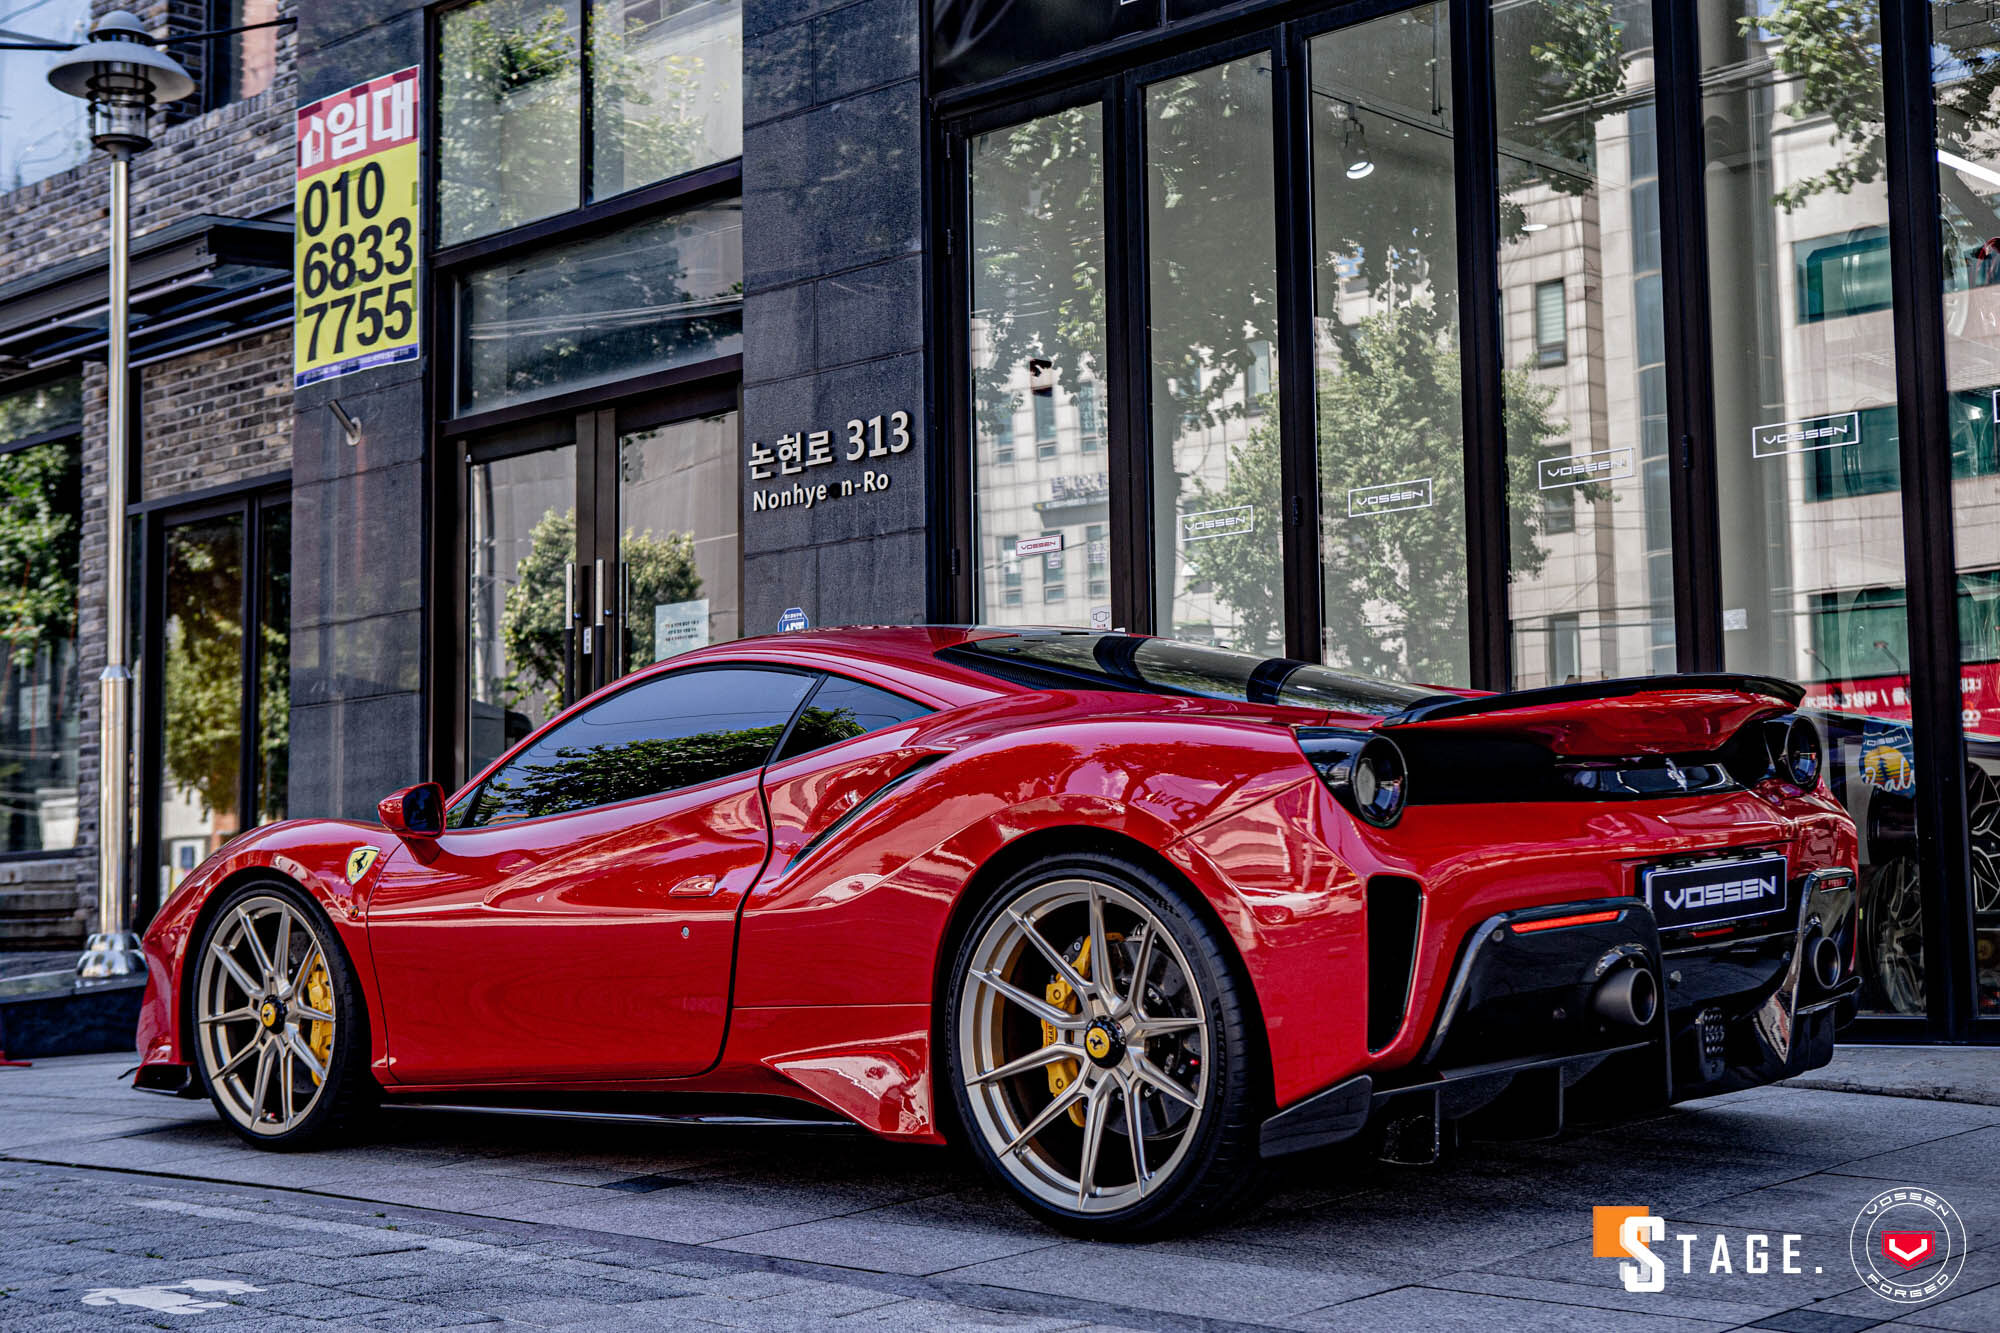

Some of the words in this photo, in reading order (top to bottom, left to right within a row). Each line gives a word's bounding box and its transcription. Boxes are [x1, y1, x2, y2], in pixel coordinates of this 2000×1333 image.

[326, 79, 414, 160] 임대
[303, 161, 385, 238] 010
[303, 216, 413, 299] 6833
[303, 279, 412, 363] 7755
[748, 430, 832, 480] 논현로
[846, 410, 910, 461] 313
[1762, 424, 1848, 445] VOSSEN
[1547, 460, 1628, 477] VOSSEN
[753, 470, 889, 511] Nonhyen-Ro
[1356, 489, 1424, 506] VOSSEN
[1184, 515, 1246, 532] VOSSEN
[1020, 540, 1057, 551] VOSSEN
[1664, 875, 1777, 910] VOSSEN
